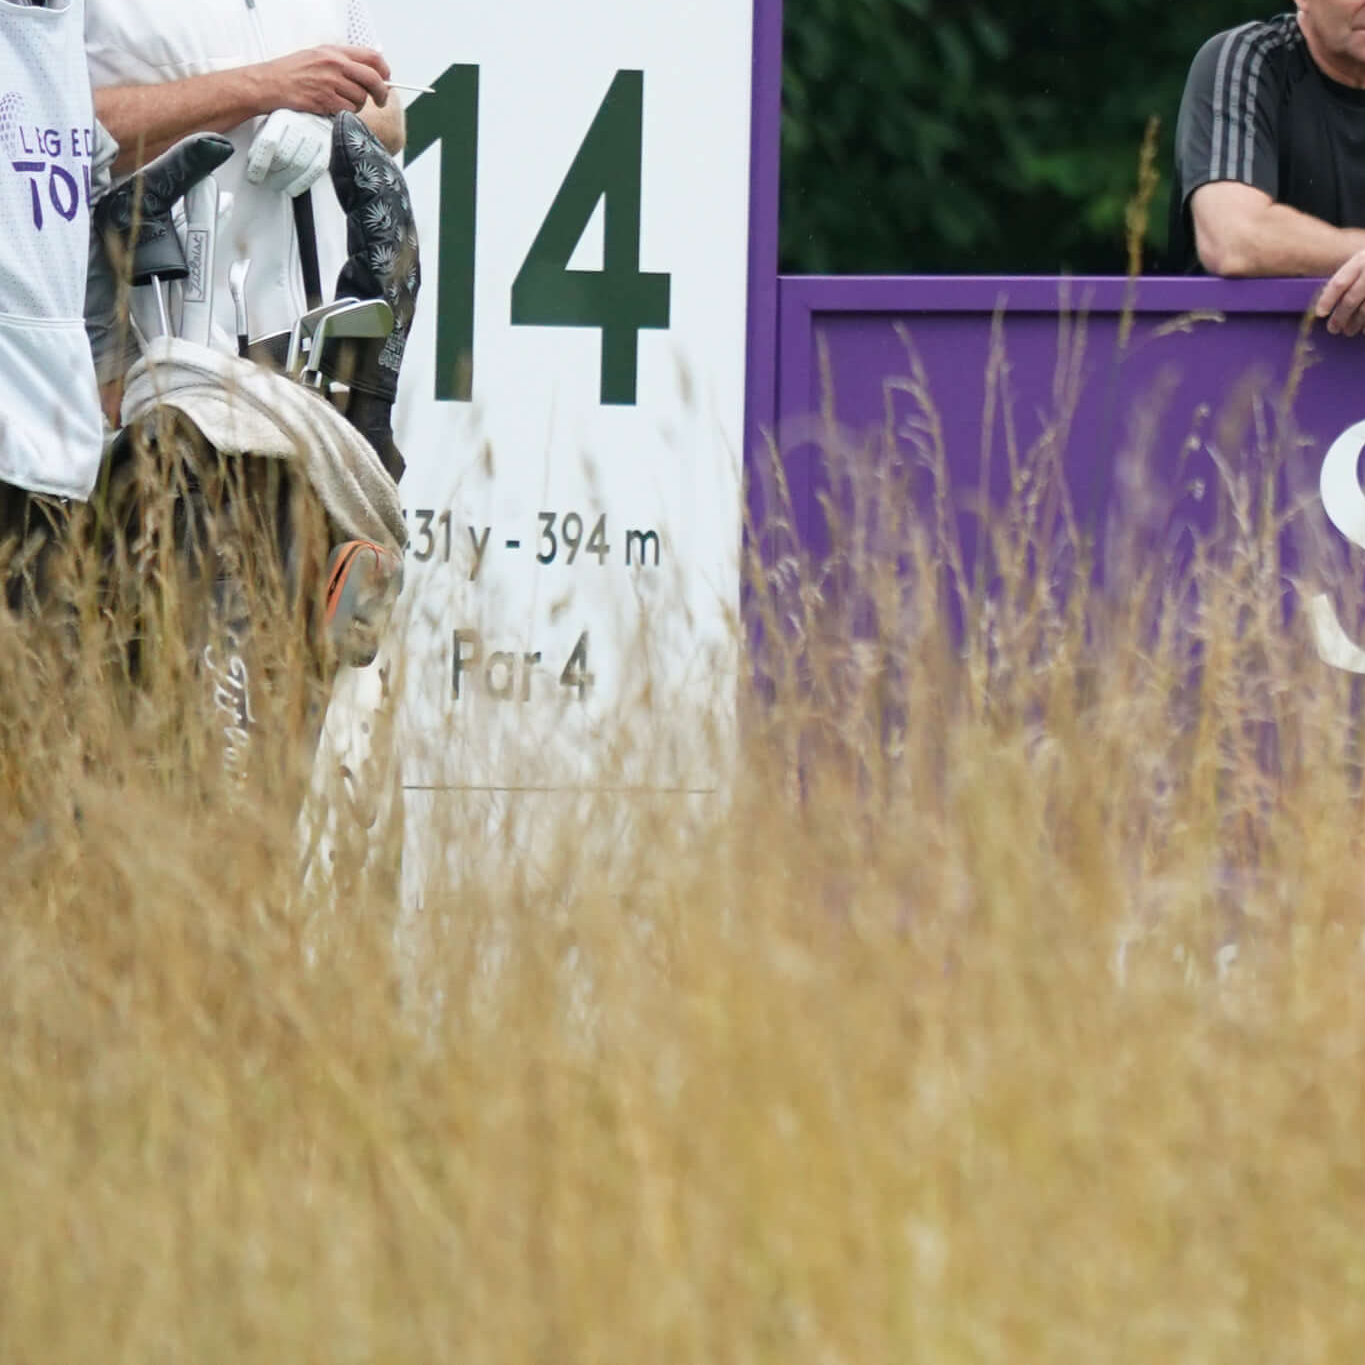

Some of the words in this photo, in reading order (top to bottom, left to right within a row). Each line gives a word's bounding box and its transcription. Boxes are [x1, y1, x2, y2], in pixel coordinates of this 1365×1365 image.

[403, 63, 671, 406] 14
[467, 525, 491, 582] y
[535, 511, 611, 566] 394
[624, 528, 661, 567] m
[451, 628, 542, 702] Par
[559, 629, 596, 702] 4
